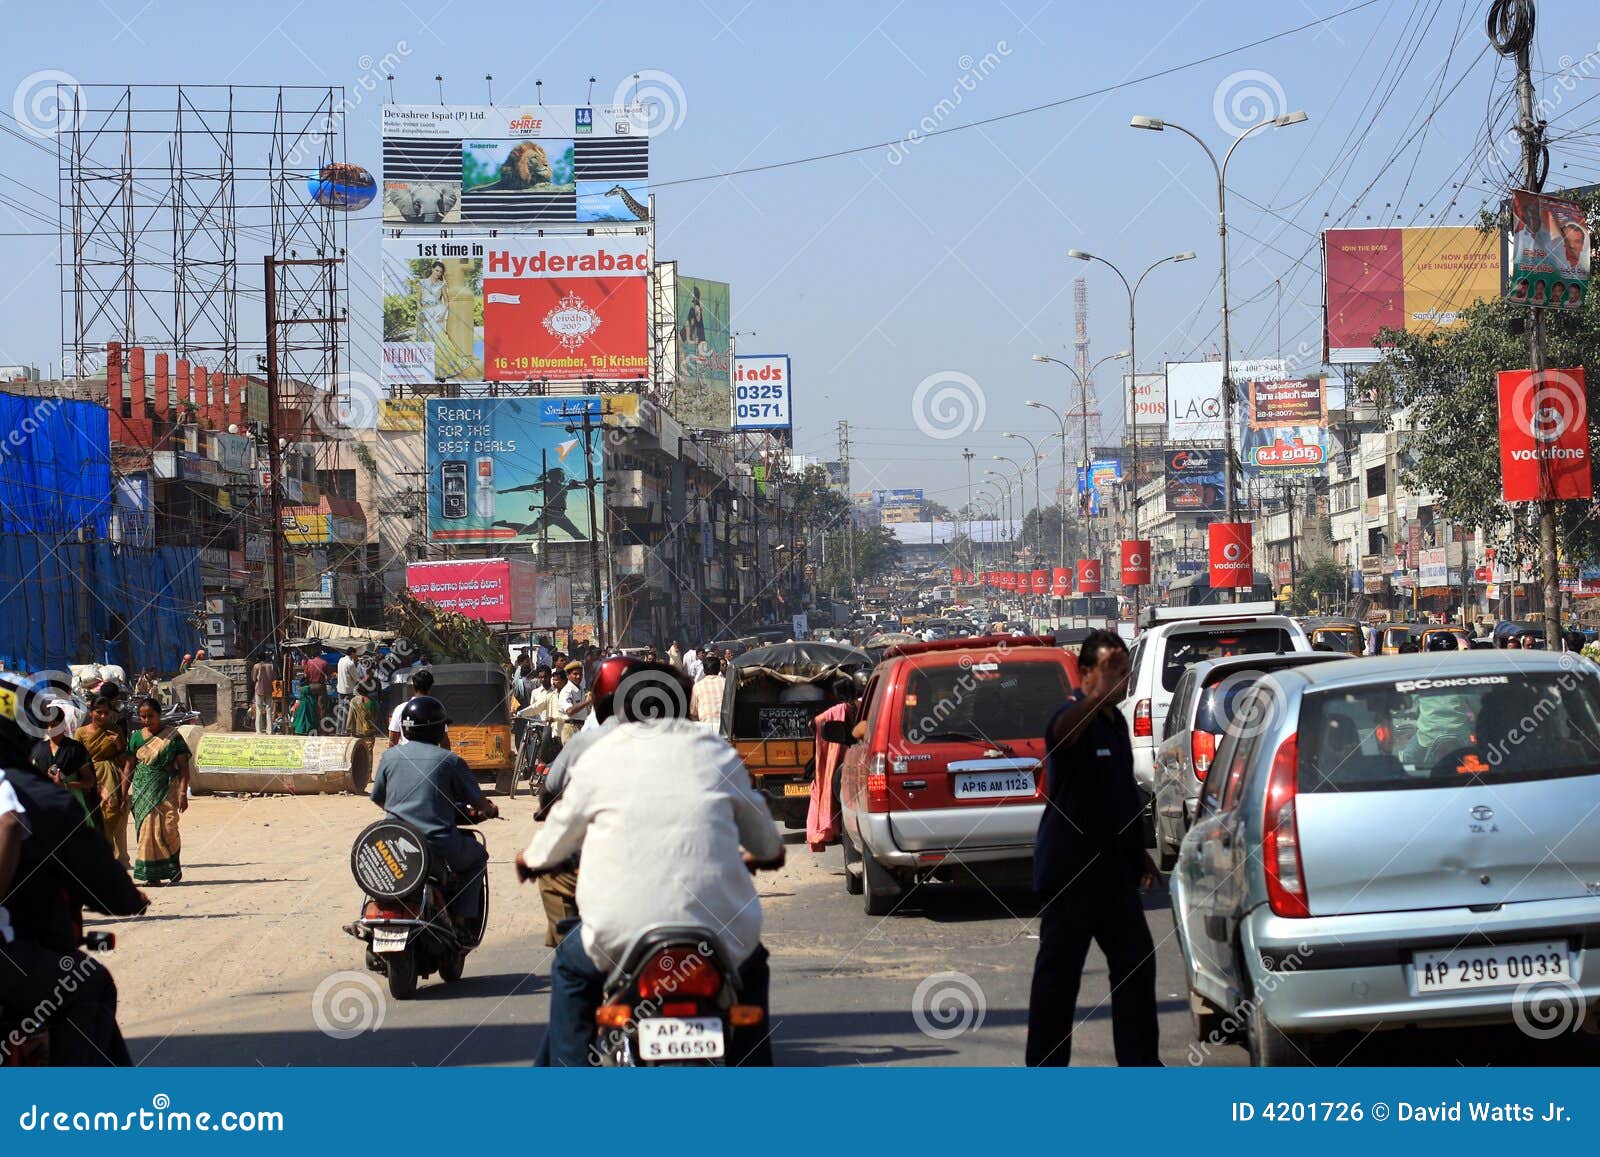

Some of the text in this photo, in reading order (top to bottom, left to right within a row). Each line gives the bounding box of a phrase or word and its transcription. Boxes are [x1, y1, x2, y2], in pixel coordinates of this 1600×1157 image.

[384, 110, 486, 121] Devashree Ispat (P) Ltd.
[509, 120, 542, 130] SHREE
[417, 243, 483, 256] 1st time in
[489, 250, 648, 277] Hyderabad
[1434, 262, 1478, 270] INSURANCE
[494, 357, 507, 368] 16
[532, 356, 587, 369] November,
[591, 355, 606, 369] Taj
[747, 365, 782, 381] ads
[737, 385, 782, 400] 0325
[438, 406, 481, 421] REACH
[438, 424, 490, 437] FOR THE
[438, 440, 516, 453] BEST DEALS
[1258, 451, 1279, 460] R.S.
[1213, 562, 1250, 570] vodafone
[1415, 676, 1509, 690] CONCORDE
[990, 781, 1003, 792] AM
[1005, 779, 1028, 791] 1125
[375, 839, 405, 880] NANDU
[362, 843, 382, 867] HONDA
[377, 866, 397, 892] ACTIVA
[1425, 952, 1563, 985] AP 29G 0033
[657, 1023, 704, 1036] AP 29
[650, 1041, 717, 1056] S 6659
